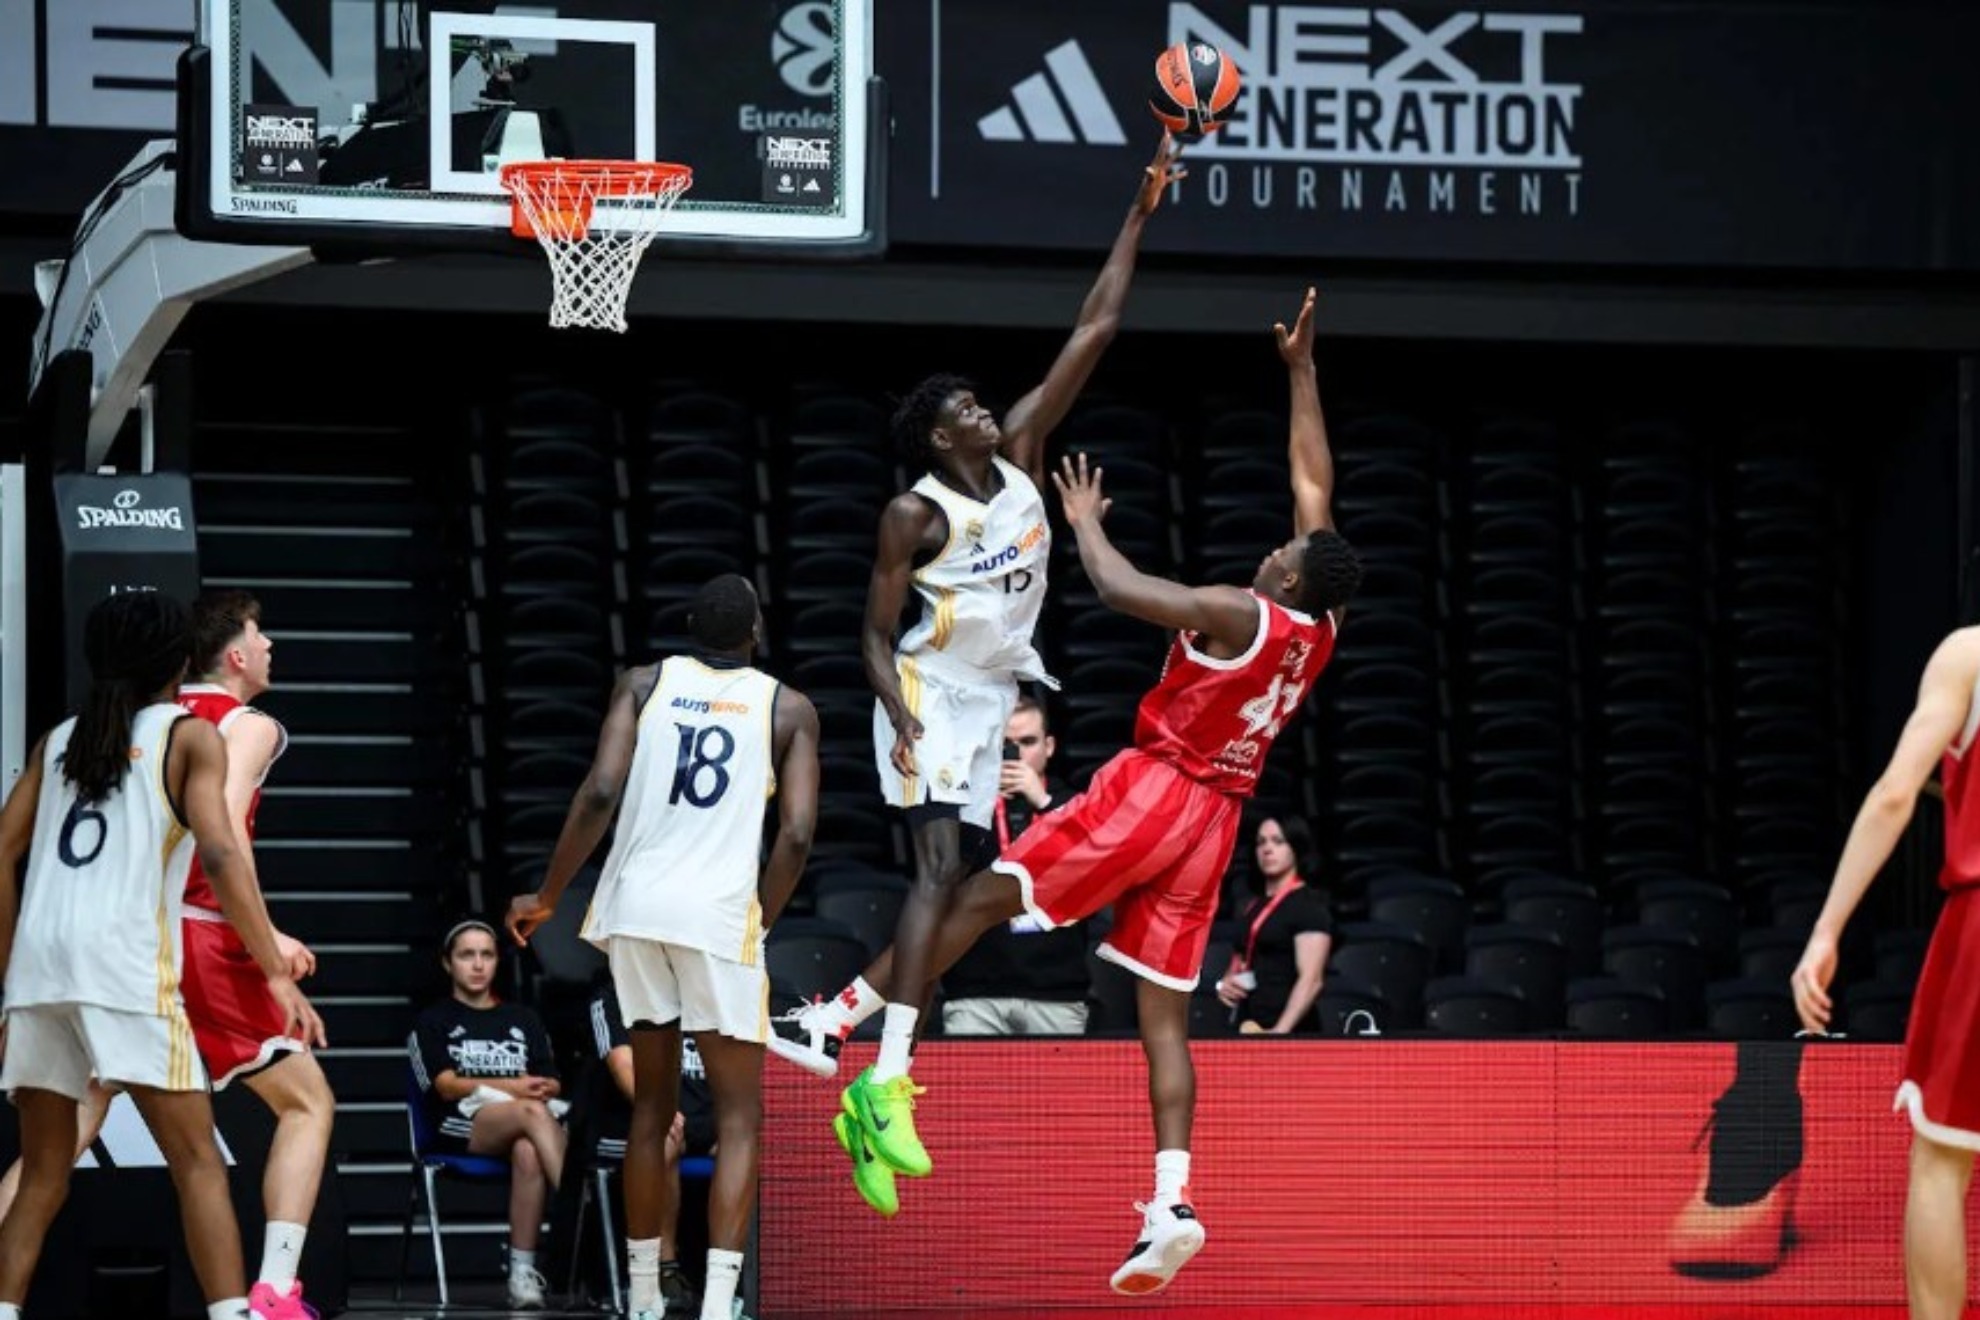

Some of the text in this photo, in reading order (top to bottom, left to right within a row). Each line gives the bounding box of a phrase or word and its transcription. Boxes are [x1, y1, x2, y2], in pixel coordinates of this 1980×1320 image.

[1168, 2, 1583, 85] NEXT
[246, 114, 315, 130] NEXT
[766, 136, 831, 151] NEXT
[1176, 84, 1580, 158] ENERATION
[231, 196, 298, 214] SPALDING
[1171, 163, 1582, 215] TOURNAMENT
[78, 506, 184, 531] SPALDING
[668, 722, 736, 809] 18
[58, 797, 108, 869] 6
